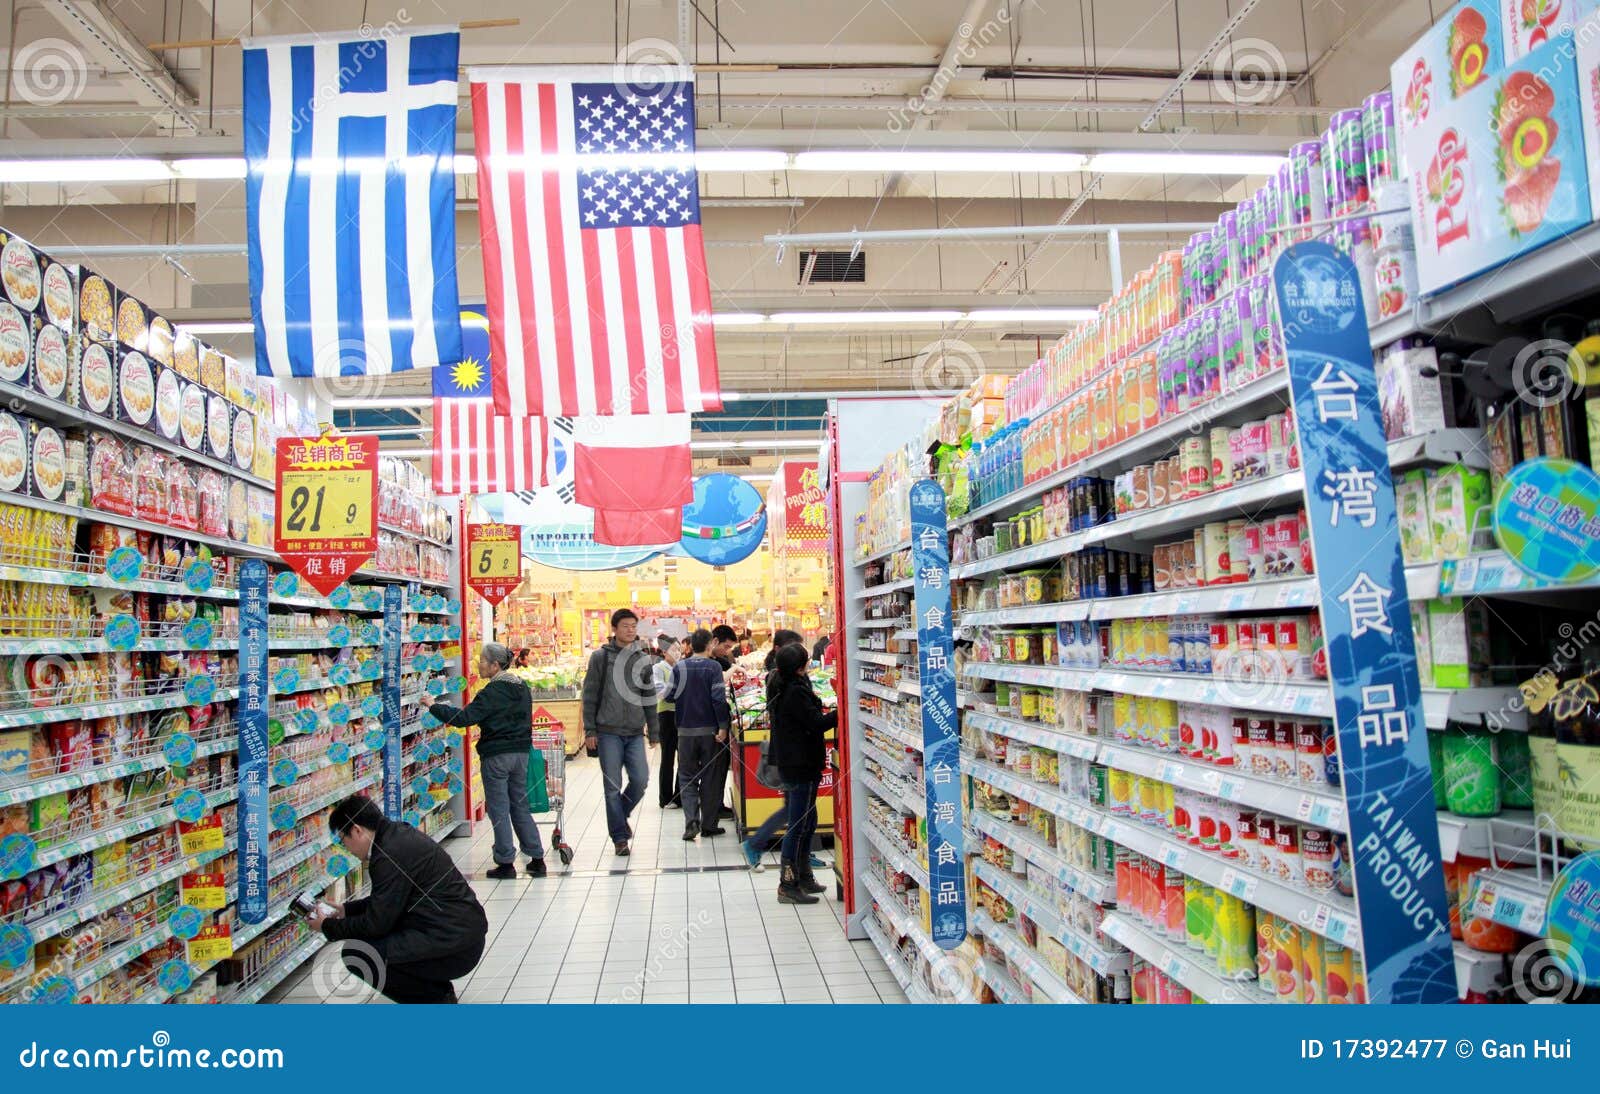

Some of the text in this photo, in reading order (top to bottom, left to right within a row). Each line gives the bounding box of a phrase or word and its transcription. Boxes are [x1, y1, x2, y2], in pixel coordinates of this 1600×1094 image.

[291, 443, 363, 463] 促销商品
[287, 486, 357, 532] 21 9
[1310, 361, 1410, 749] 台湾食品
[306, 557, 346, 576] 促销
[479, 549, 509, 574] 5 2
[919, 527, 947, 670] 台湾食品
[932, 761, 959, 905] 台湾食品
[1367, 790, 1434, 883] TAIWAN
[1358, 832, 1446, 943] PRODUCT
